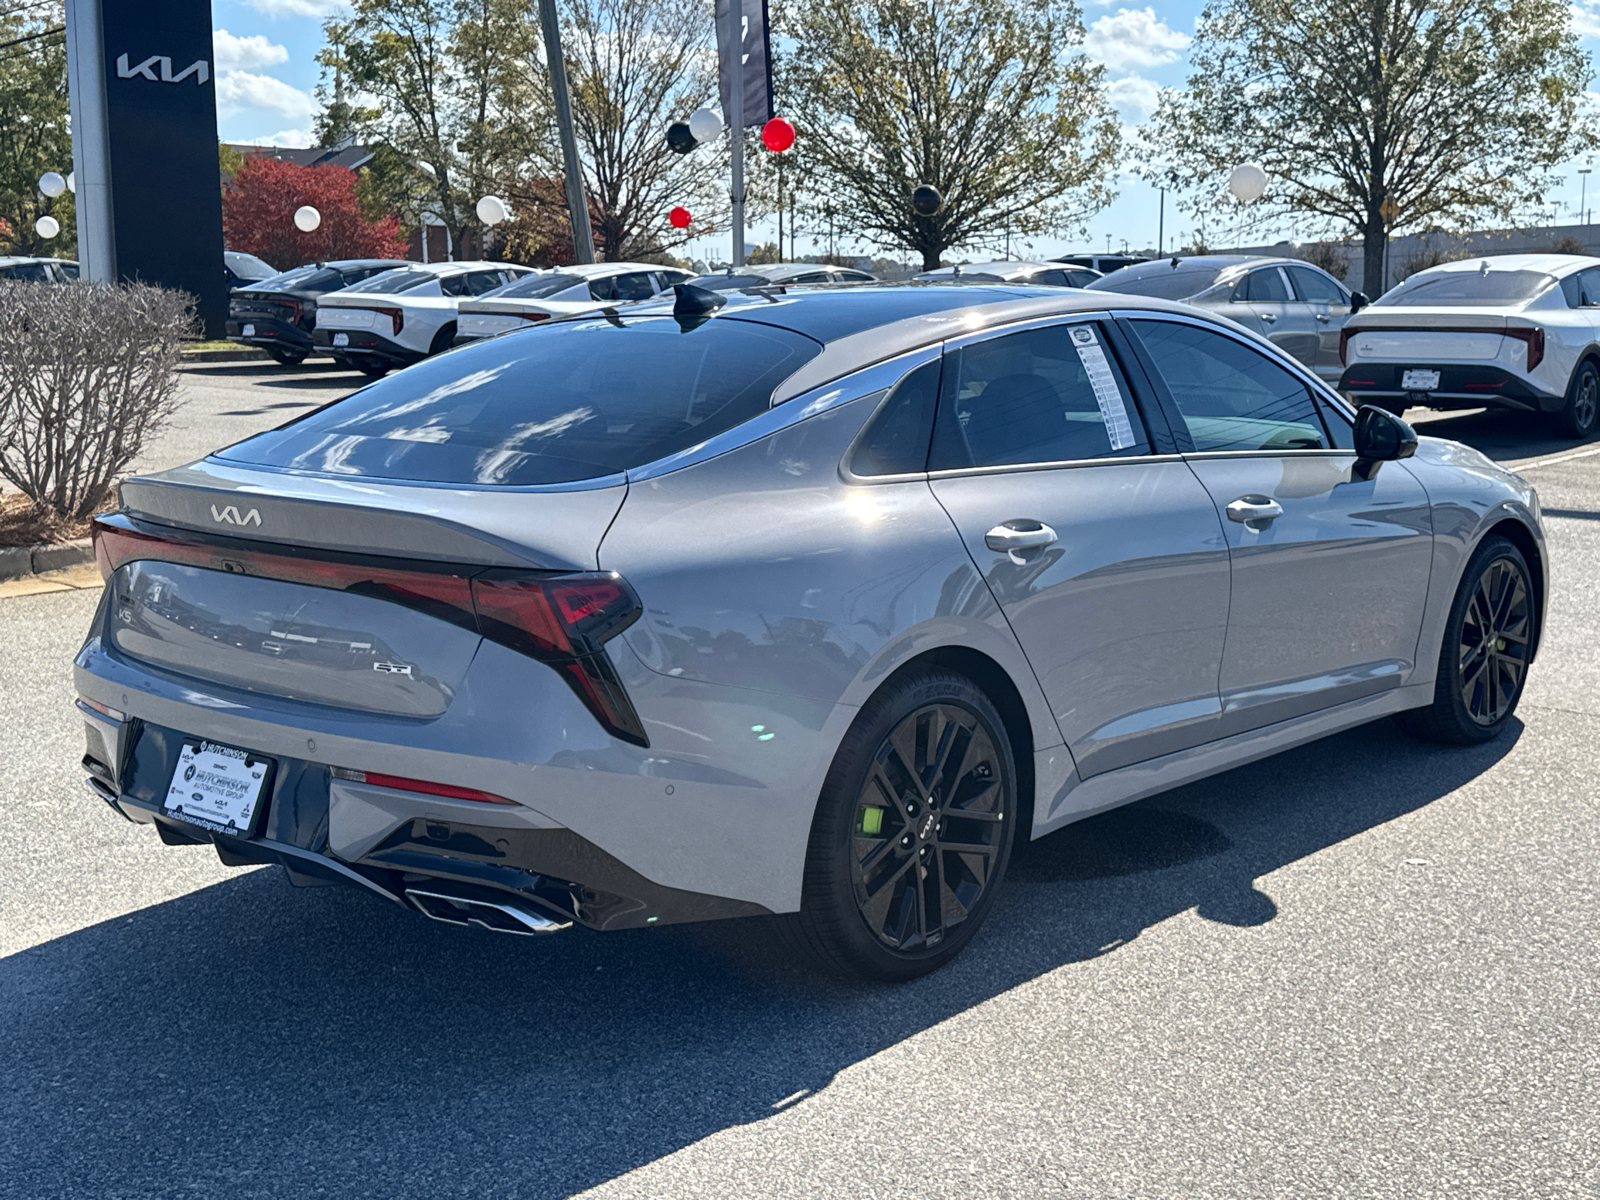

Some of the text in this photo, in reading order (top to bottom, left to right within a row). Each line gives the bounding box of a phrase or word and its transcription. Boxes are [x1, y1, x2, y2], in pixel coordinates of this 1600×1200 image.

[116, 52, 209, 86] KIA
[210, 503, 262, 528] KIA
[119, 608, 131, 623] K5
[924, 684, 962, 694] ZERO
[207, 743, 249, 761] HUTCHINSON
[193, 782, 225, 796] AUTOMOTIVE
[225, 788, 245, 800] GROUP
[195, 772, 251, 794] HUTCHINSON
